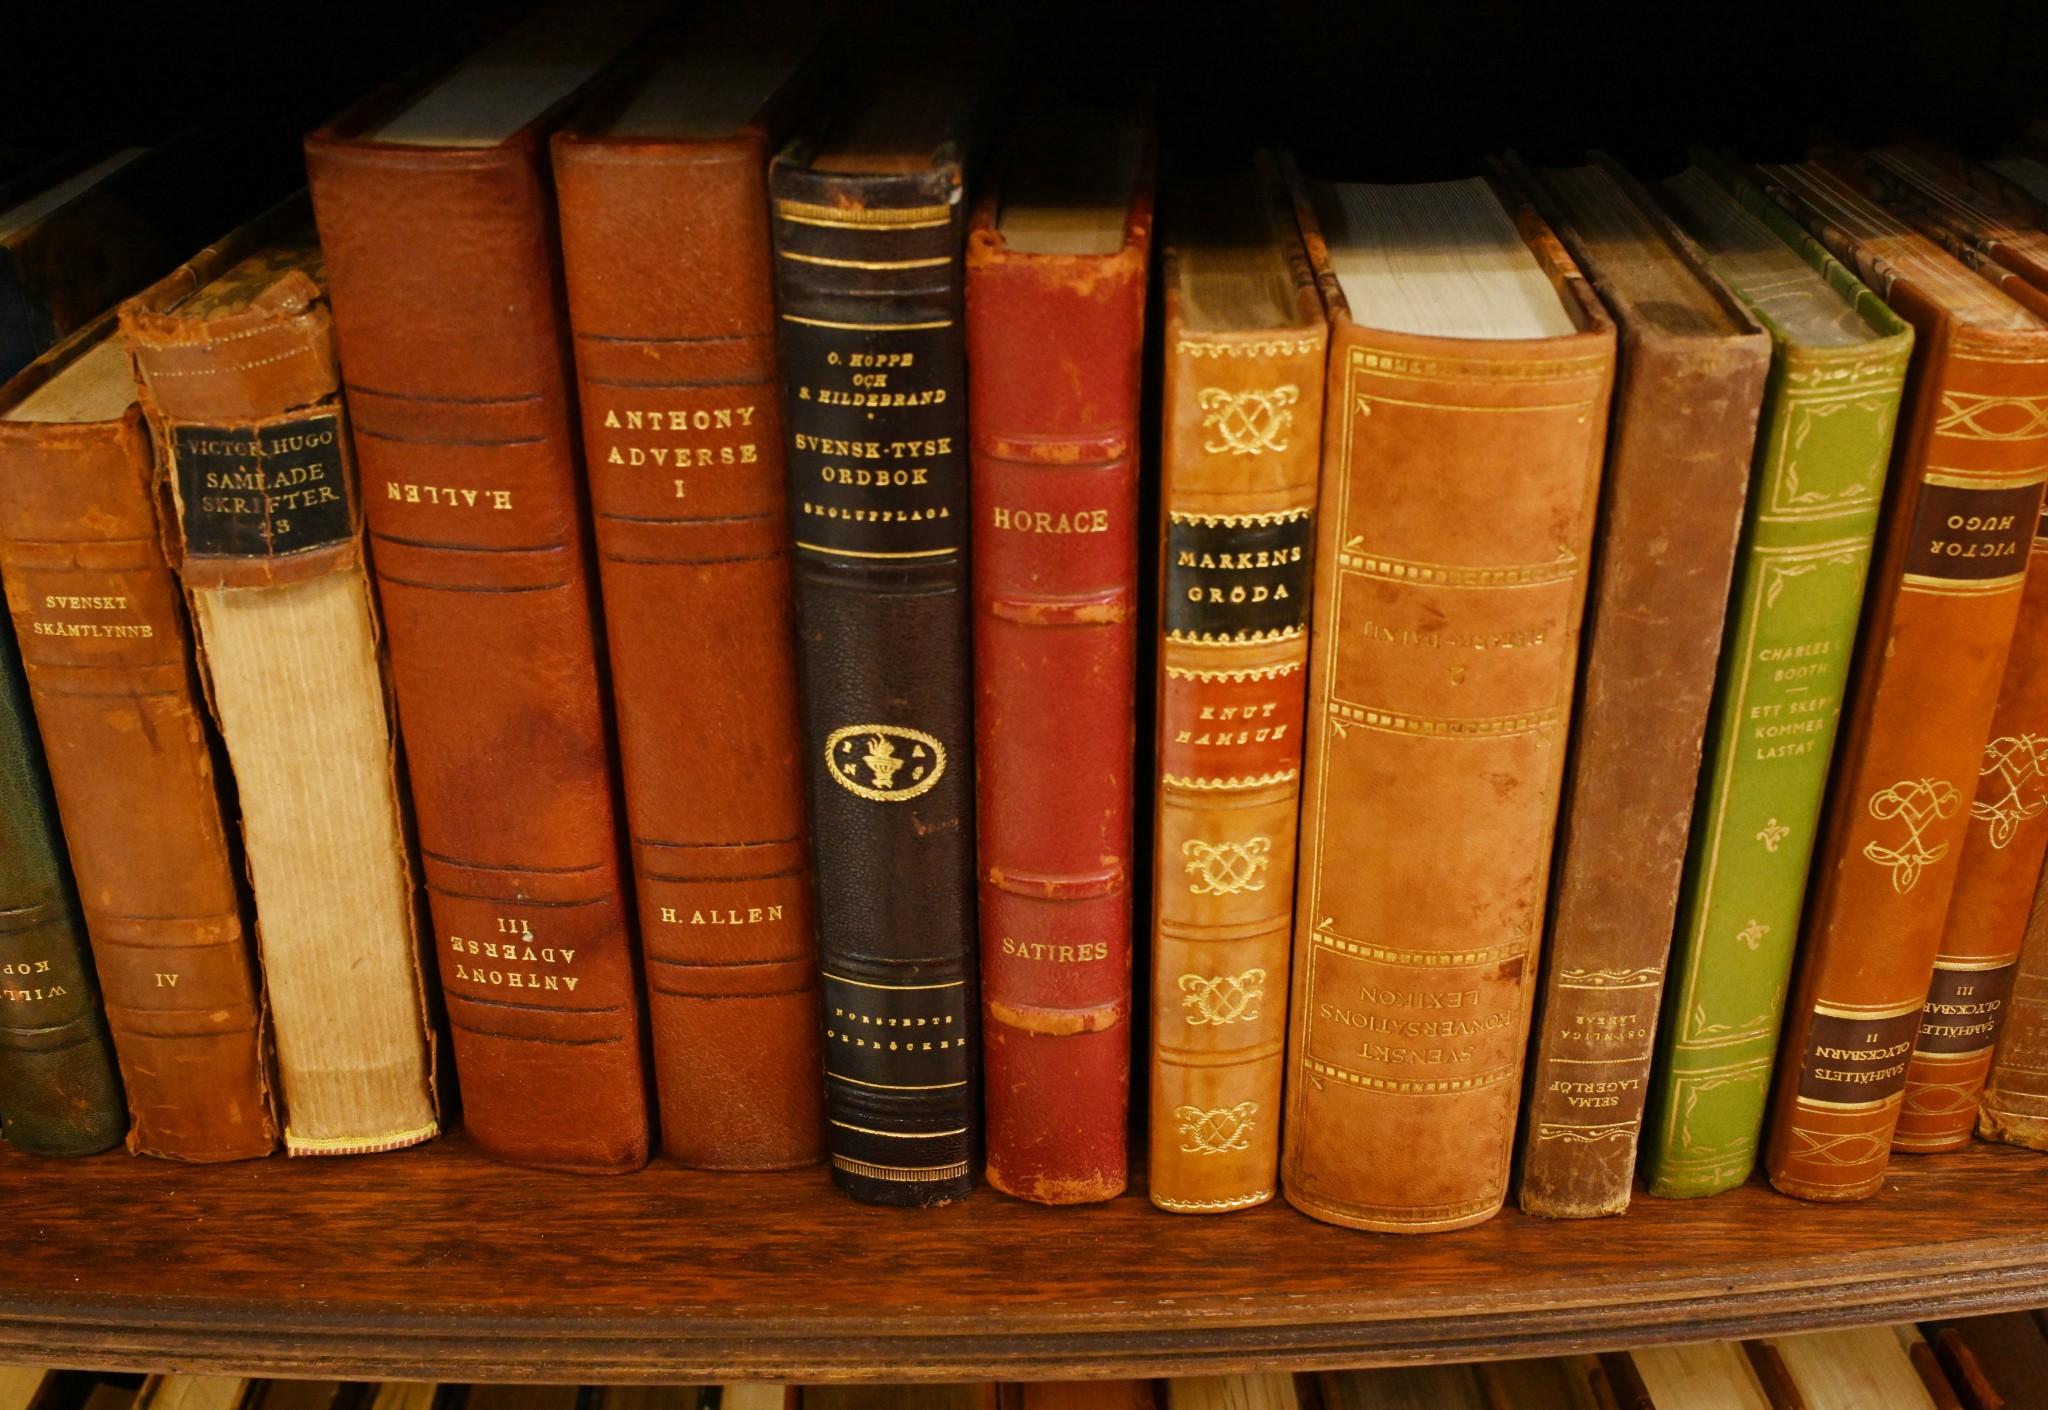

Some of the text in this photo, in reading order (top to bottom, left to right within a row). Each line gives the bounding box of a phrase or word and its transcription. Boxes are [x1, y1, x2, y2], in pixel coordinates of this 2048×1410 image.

[850, 353, 914, 367] HOPPE
[853, 374, 888, 388] OCH
[818, 389, 947, 407] HILDEBRAND
[605, 407, 755, 430] ANTHONY
[273, 431, 333, 454] HUGO
[608, 444, 757, 466] ADVERSE
[822, 466, 928, 486] ORDBOK
[674, 480, 685, 498] I
[202, 486, 339, 514] SKRIFTER
[993, 507, 1109, 533] HORACE
[1947, 515, 2016, 531] HUGO
[1177, 546, 1301, 569] MARKENS
[1929, 541, 2016, 558] VICTOR
[46, 595, 127, 610] SVENSKT
[1187, 583, 1289, 604] GRÖDA
[33, 622, 153, 638] SKÄMTLYNNE
[1759, 641, 1831, 661] CHARLES
[1774, 664, 1828, 682] BOOTH
[1200, 703, 1277, 720] KNUT
[1751, 705, 1782, 719] ETT
[1175, 725, 1288, 745] HAMSUN
[1755, 719, 1824, 738] KOMMER
[1757, 741, 1815, 760] LASTAT
[497, 918, 532, 935] III
[450, 935, 576, 963] ADVERSE
[1002, 937, 1108, 963] SATIRES
[155, 974, 179, 988] IV
[456, 964, 579, 991] ANTHONY
[0, 985, 67, 1001] WILL
[1359, 986, 1480, 1010] LEXIKON
[1956, 986, 1975, 996] III
[1320, 1003, 1511, 1037] KONVERSATIONS
[1561, 1028, 1646, 1040] OSYNLIGA
[1866, 1033, 1879, 1043] II
[1358, 1042, 1475, 1065] SVENSKT
[1816, 1041, 1910, 1061] OLYCKSBARN
[1815, 1063, 1905, 1084] SAMHÄLLETS
[1550, 1079, 1640, 1094] LAGERLÖF
[1568, 1096, 1620, 1108] SELMA
